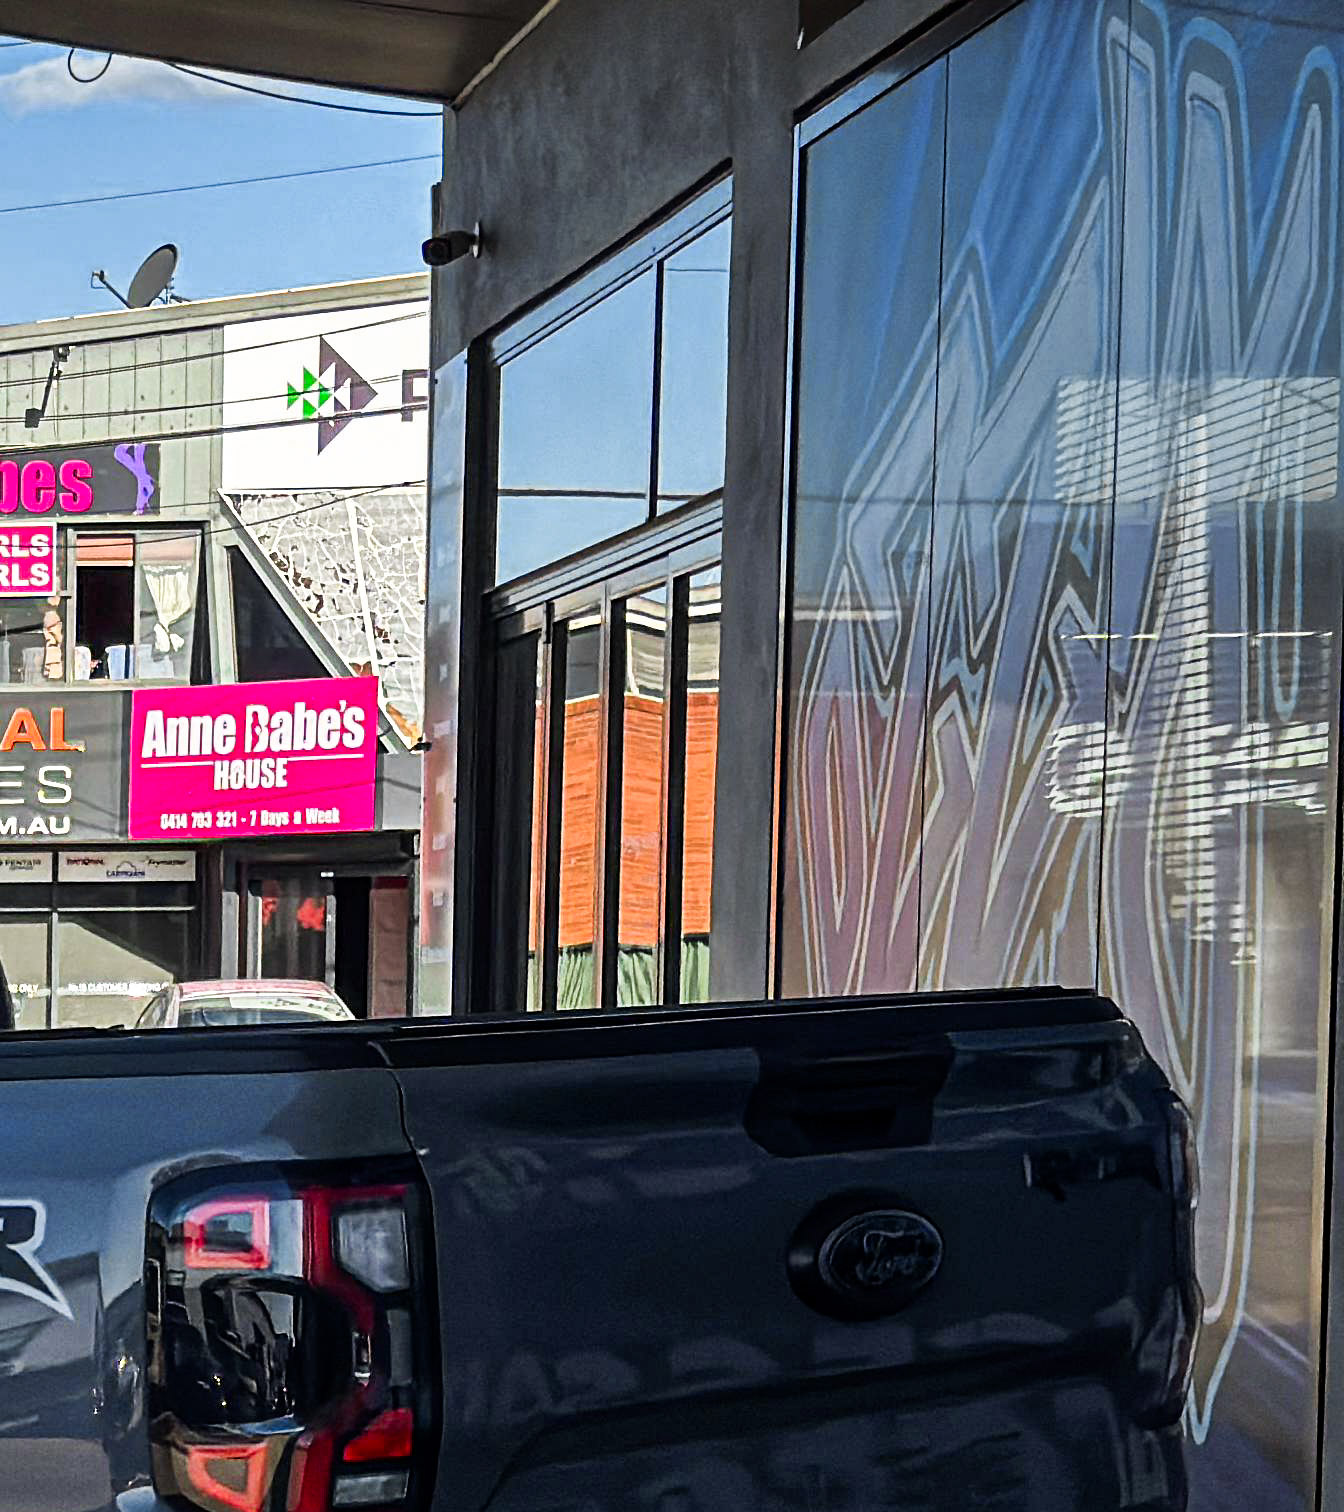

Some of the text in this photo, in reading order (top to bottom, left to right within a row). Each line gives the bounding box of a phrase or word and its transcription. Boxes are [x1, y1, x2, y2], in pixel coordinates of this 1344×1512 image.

[141, 700, 366, 759] Anne Babe's
[213, 757, 289, 791] HOUSE
[216, 811, 237, 828] 321
[249, 810, 257, 827] 7
[260, 809, 290, 827] Days
[305, 807, 340, 824] Week
